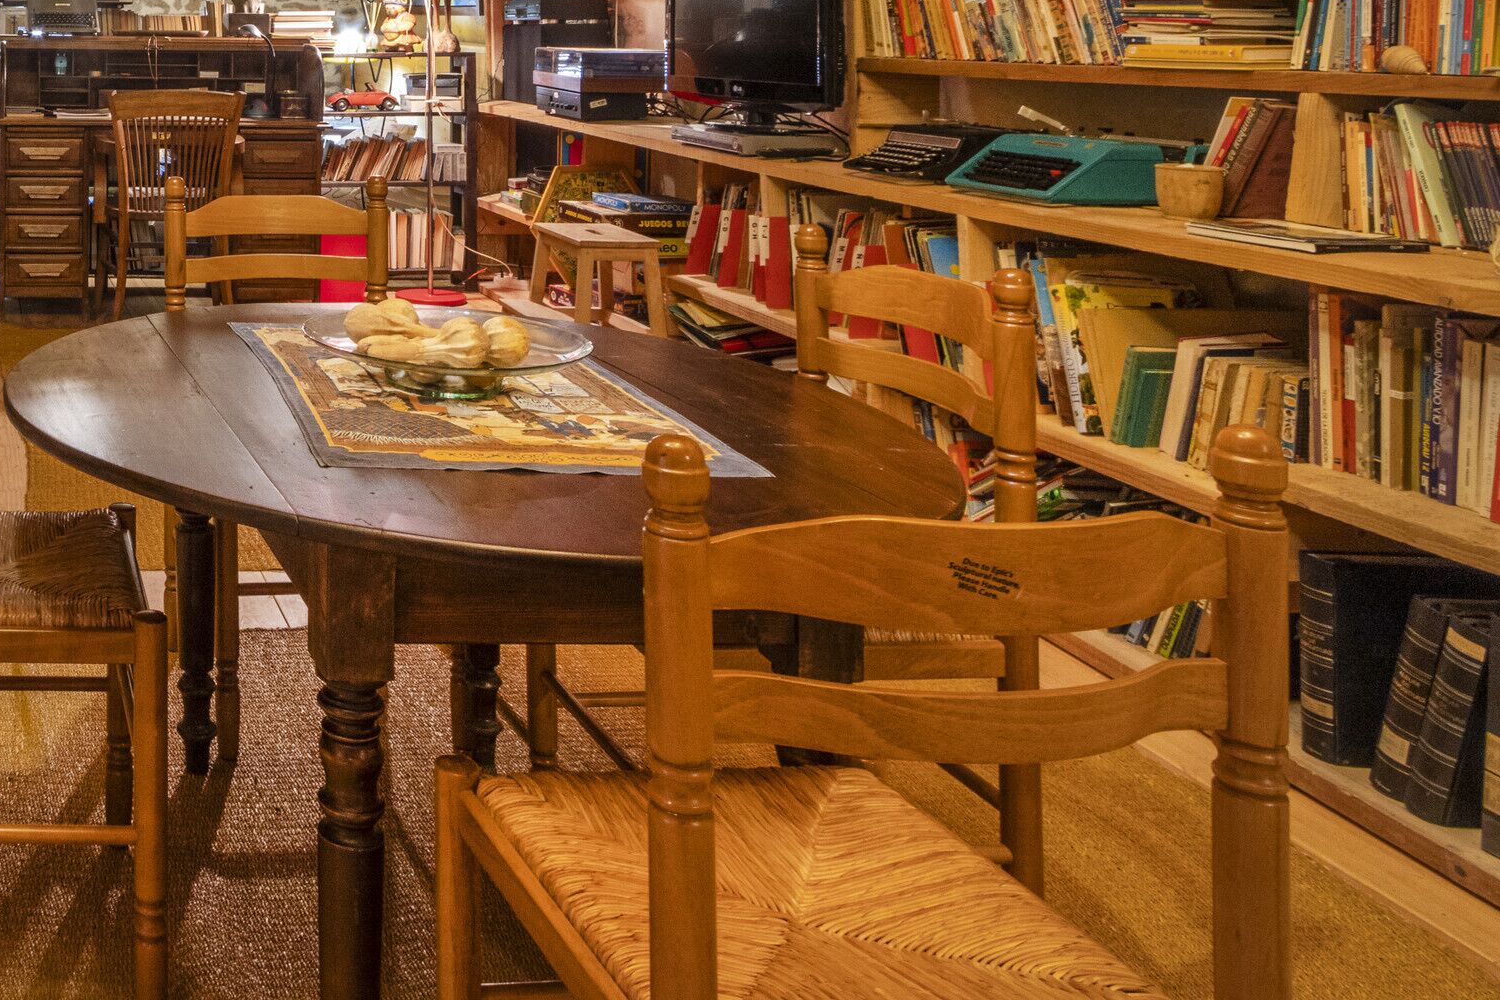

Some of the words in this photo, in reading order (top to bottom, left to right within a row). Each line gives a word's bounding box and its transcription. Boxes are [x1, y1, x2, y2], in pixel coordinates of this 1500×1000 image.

[643, 203, 688, 213] MONOPOLY
[638, 220, 673, 229] JUEGOS
[1068, 354, 1082, 405] HUERTO
[1432, 358, 1441, 405] AVANZADO
[948, 561, 992, 579] Sculptural
[963, 557, 979, 568] Due
[953, 571, 980, 584] Please
[981, 580, 1010, 594] Handle
[958, 581, 977, 593] With
